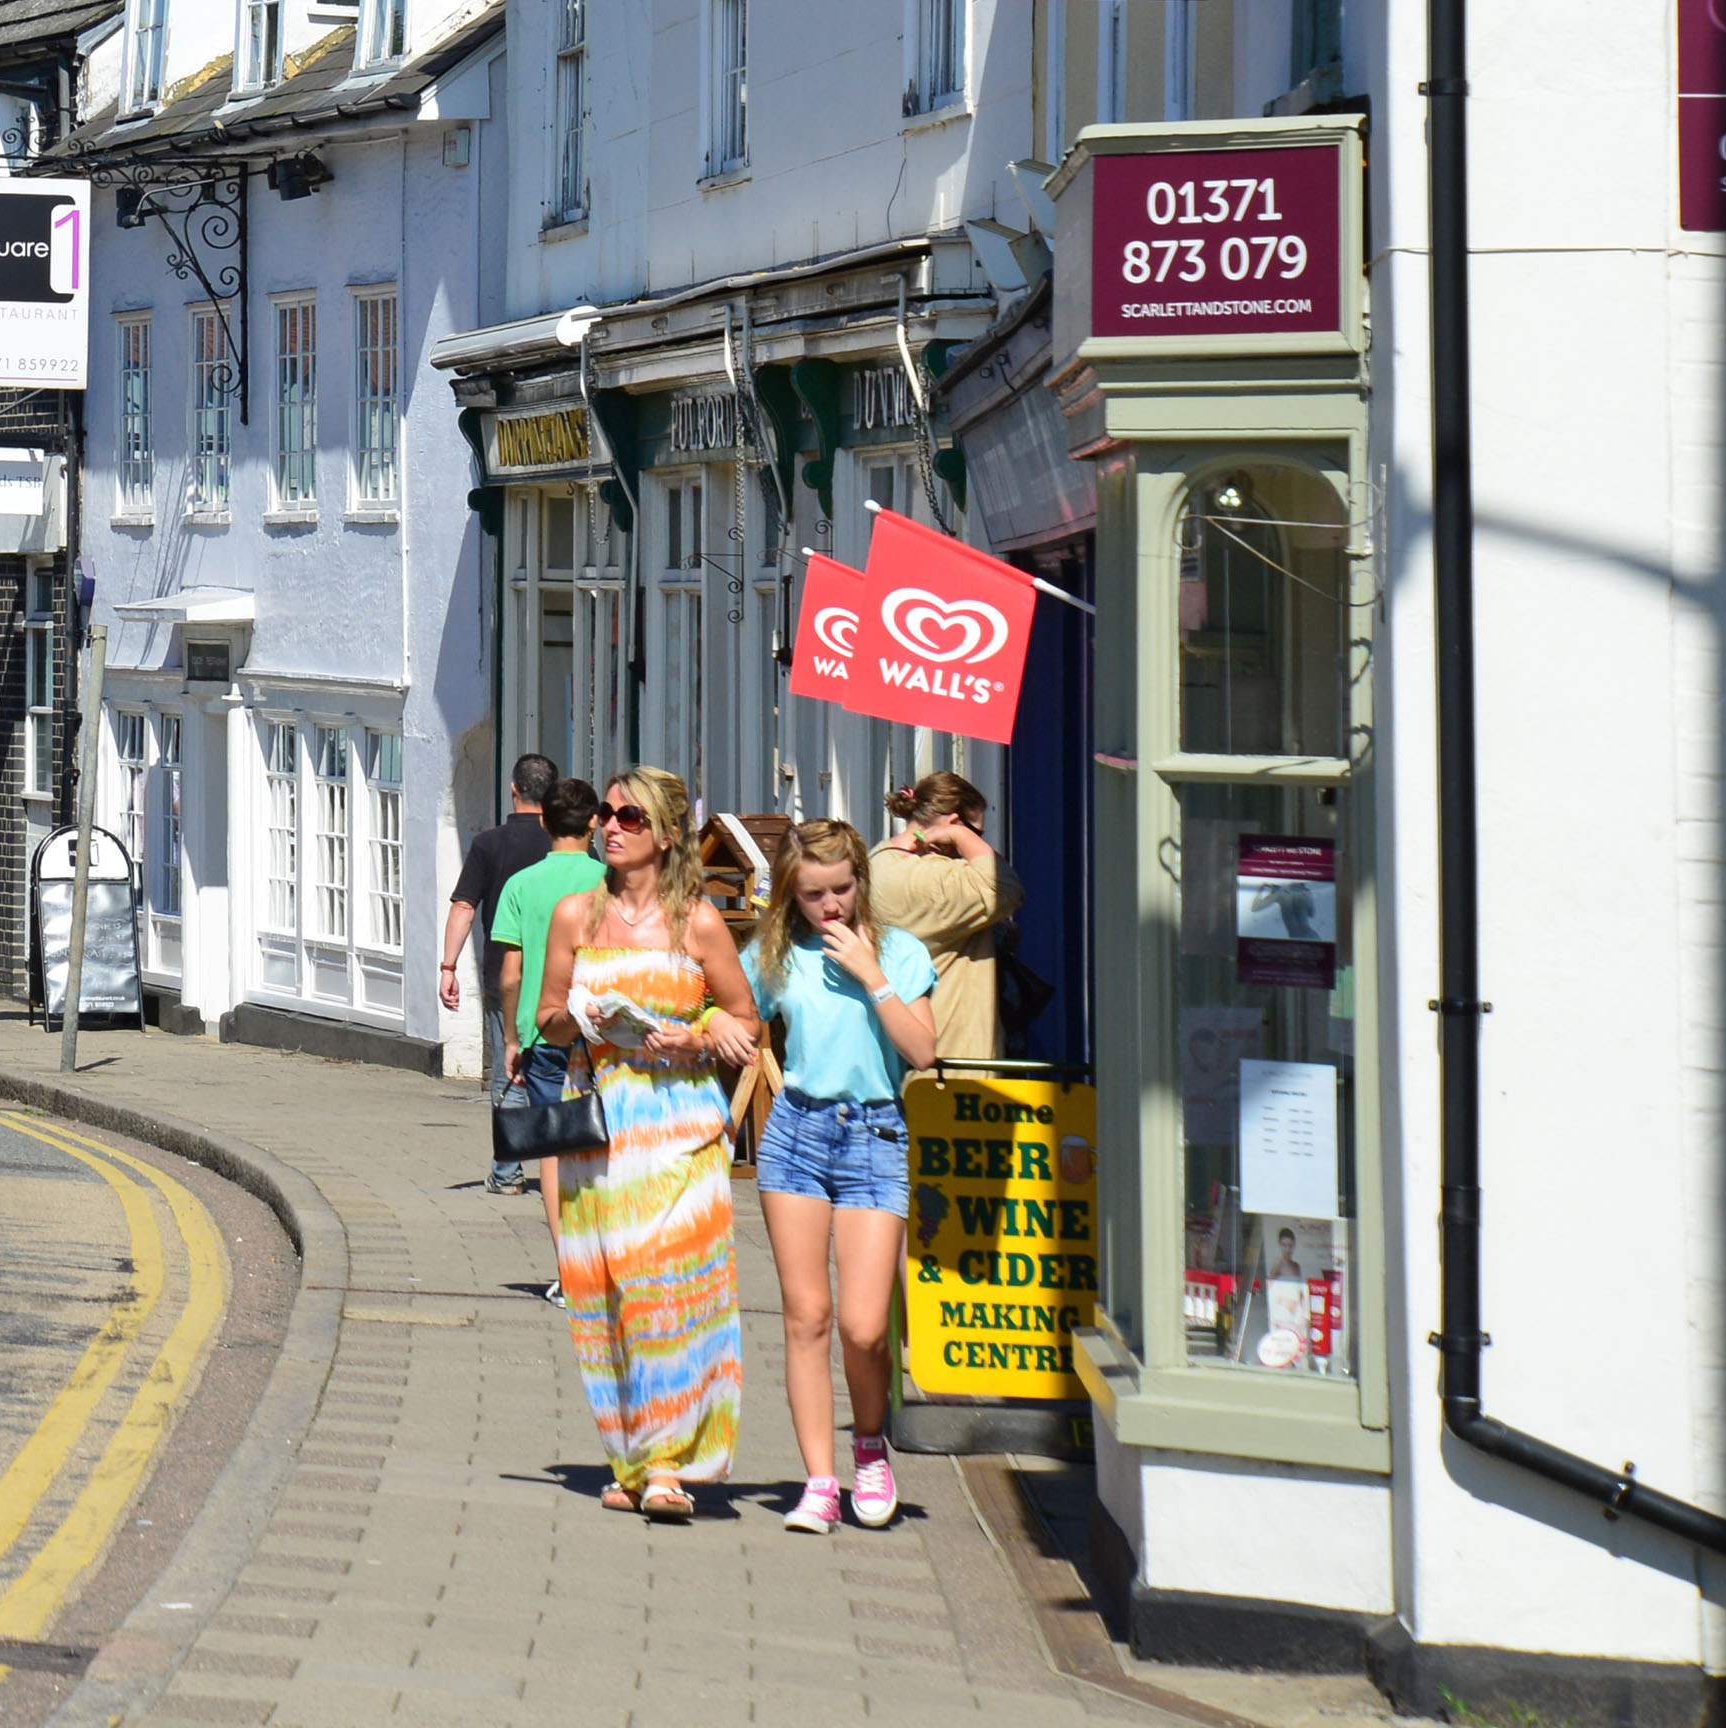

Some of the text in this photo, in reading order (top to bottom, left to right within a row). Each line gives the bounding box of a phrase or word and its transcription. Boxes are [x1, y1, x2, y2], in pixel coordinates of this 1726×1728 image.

[1146, 177, 1283, 226] 01371
[54, 209, 80, 290] 1
[1122, 234, 1308, 284] 873 079
[1120, 298, 1312, 318] SCARLETTANDSTONE.COM
[17, 358, 79, 373] 859922
[670, 393, 735, 453] PULFORD
[15, 476, 42, 489] TSB
[878, 657, 993, 705] WALL'S
[952, 1092, 1055, 1125] Home
[916, 1135, 1053, 1181] BEER
[955, 1194, 1090, 1241] WINE
[917, 1249, 1097, 1291] & CIDER
[940, 1300, 1081, 1334] MAKING
